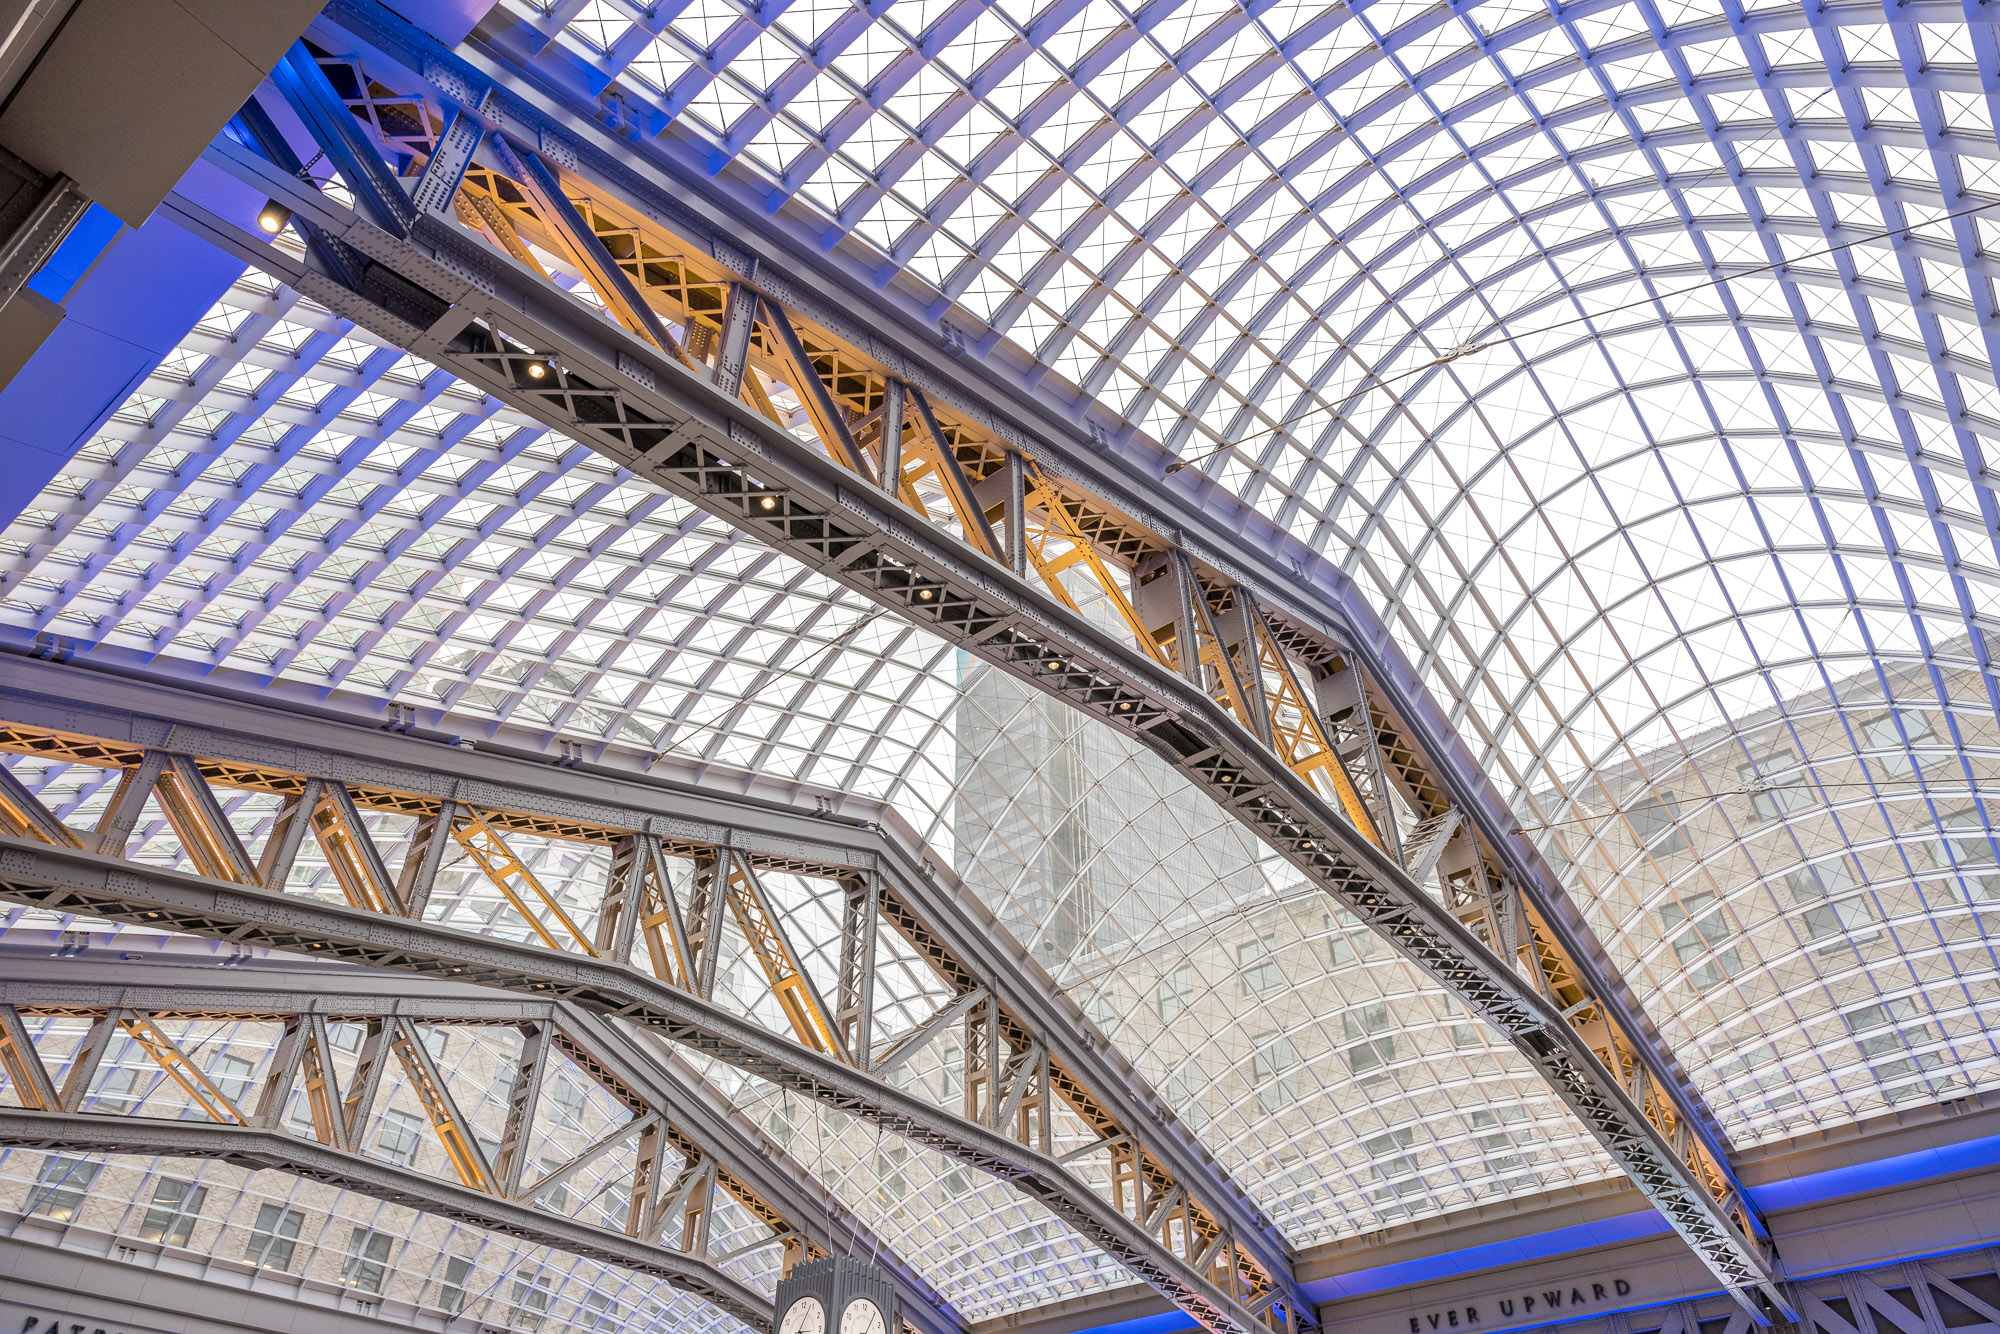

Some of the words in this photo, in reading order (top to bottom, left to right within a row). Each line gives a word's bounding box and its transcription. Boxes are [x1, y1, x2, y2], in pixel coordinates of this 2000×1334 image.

[862, 1303, 868, 1311] 12
[1408, 1307, 1480, 1333] EVER
[1499, 1279, 1631, 1317] UPWARD
[817, 1311, 821, 1319] 2
[847, 1312, 852, 1320] 10
[785, 1318, 791, 1326] 10
[877, 1321, 881, 1329] 2
[818, 1325, 822, 1333] 3
